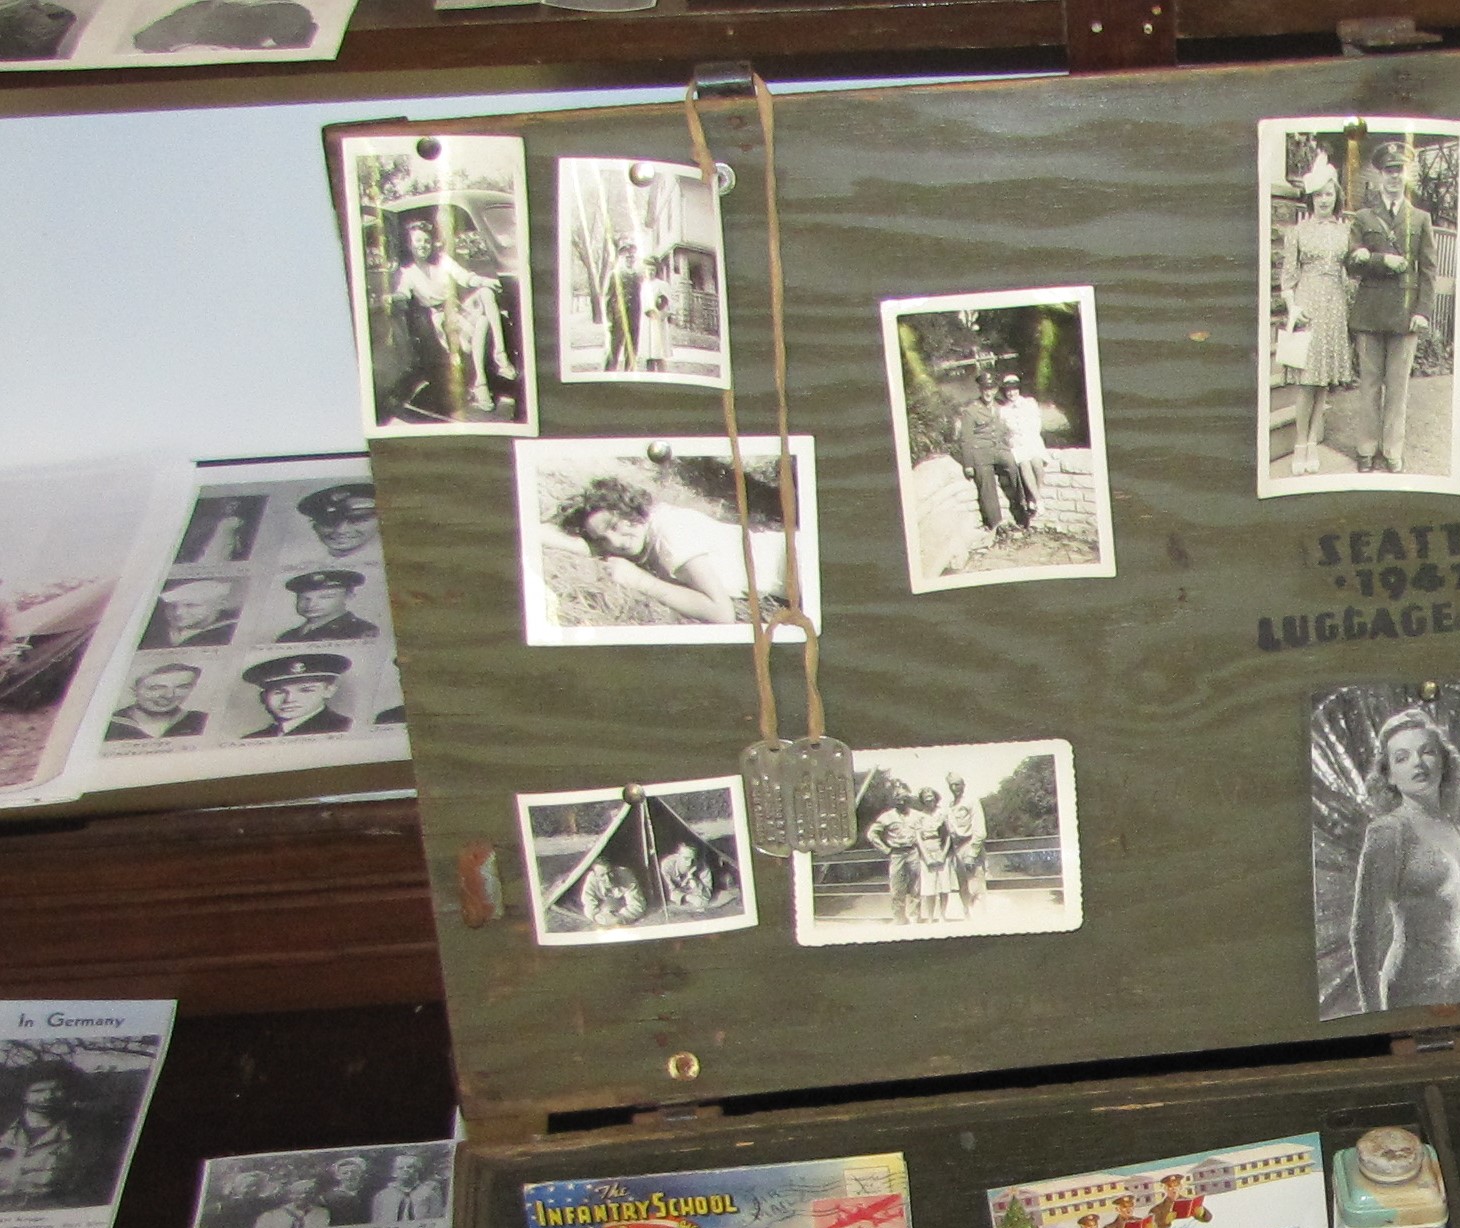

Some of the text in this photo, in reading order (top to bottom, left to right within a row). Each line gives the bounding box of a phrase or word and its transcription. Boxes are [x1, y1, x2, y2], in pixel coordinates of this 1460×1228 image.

[1257, 601, 1455, 651] LUGGAGE
[18, 1012, 125, 1029] In Germany
[594, 1182, 629, 1200] The
